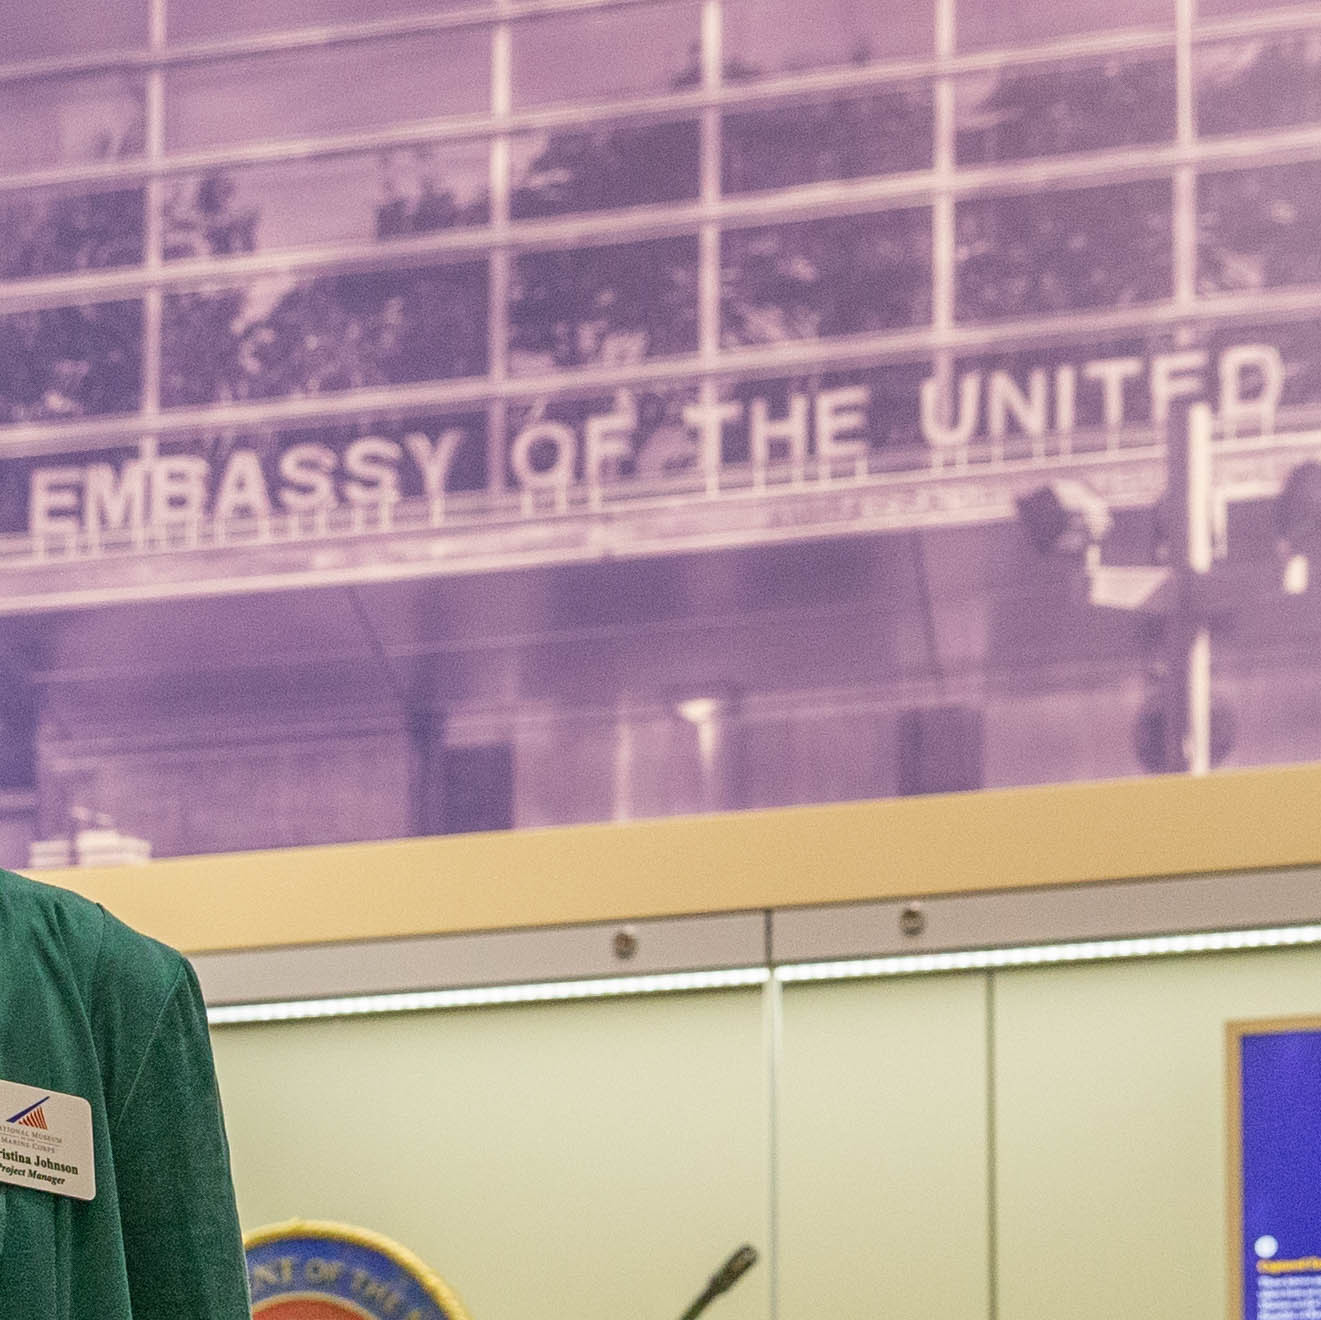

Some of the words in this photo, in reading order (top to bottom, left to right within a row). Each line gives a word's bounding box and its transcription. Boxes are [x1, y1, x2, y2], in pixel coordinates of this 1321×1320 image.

[26, 428, 464, 539] EMBASSY
[512, 404, 638, 490] OF
[683, 384, 870, 473] THE
[920, 344, 1283, 446] UNITED
[34, 1155, 78, 1175] Johnson
[27, 1169, 65, 1185] Manager
